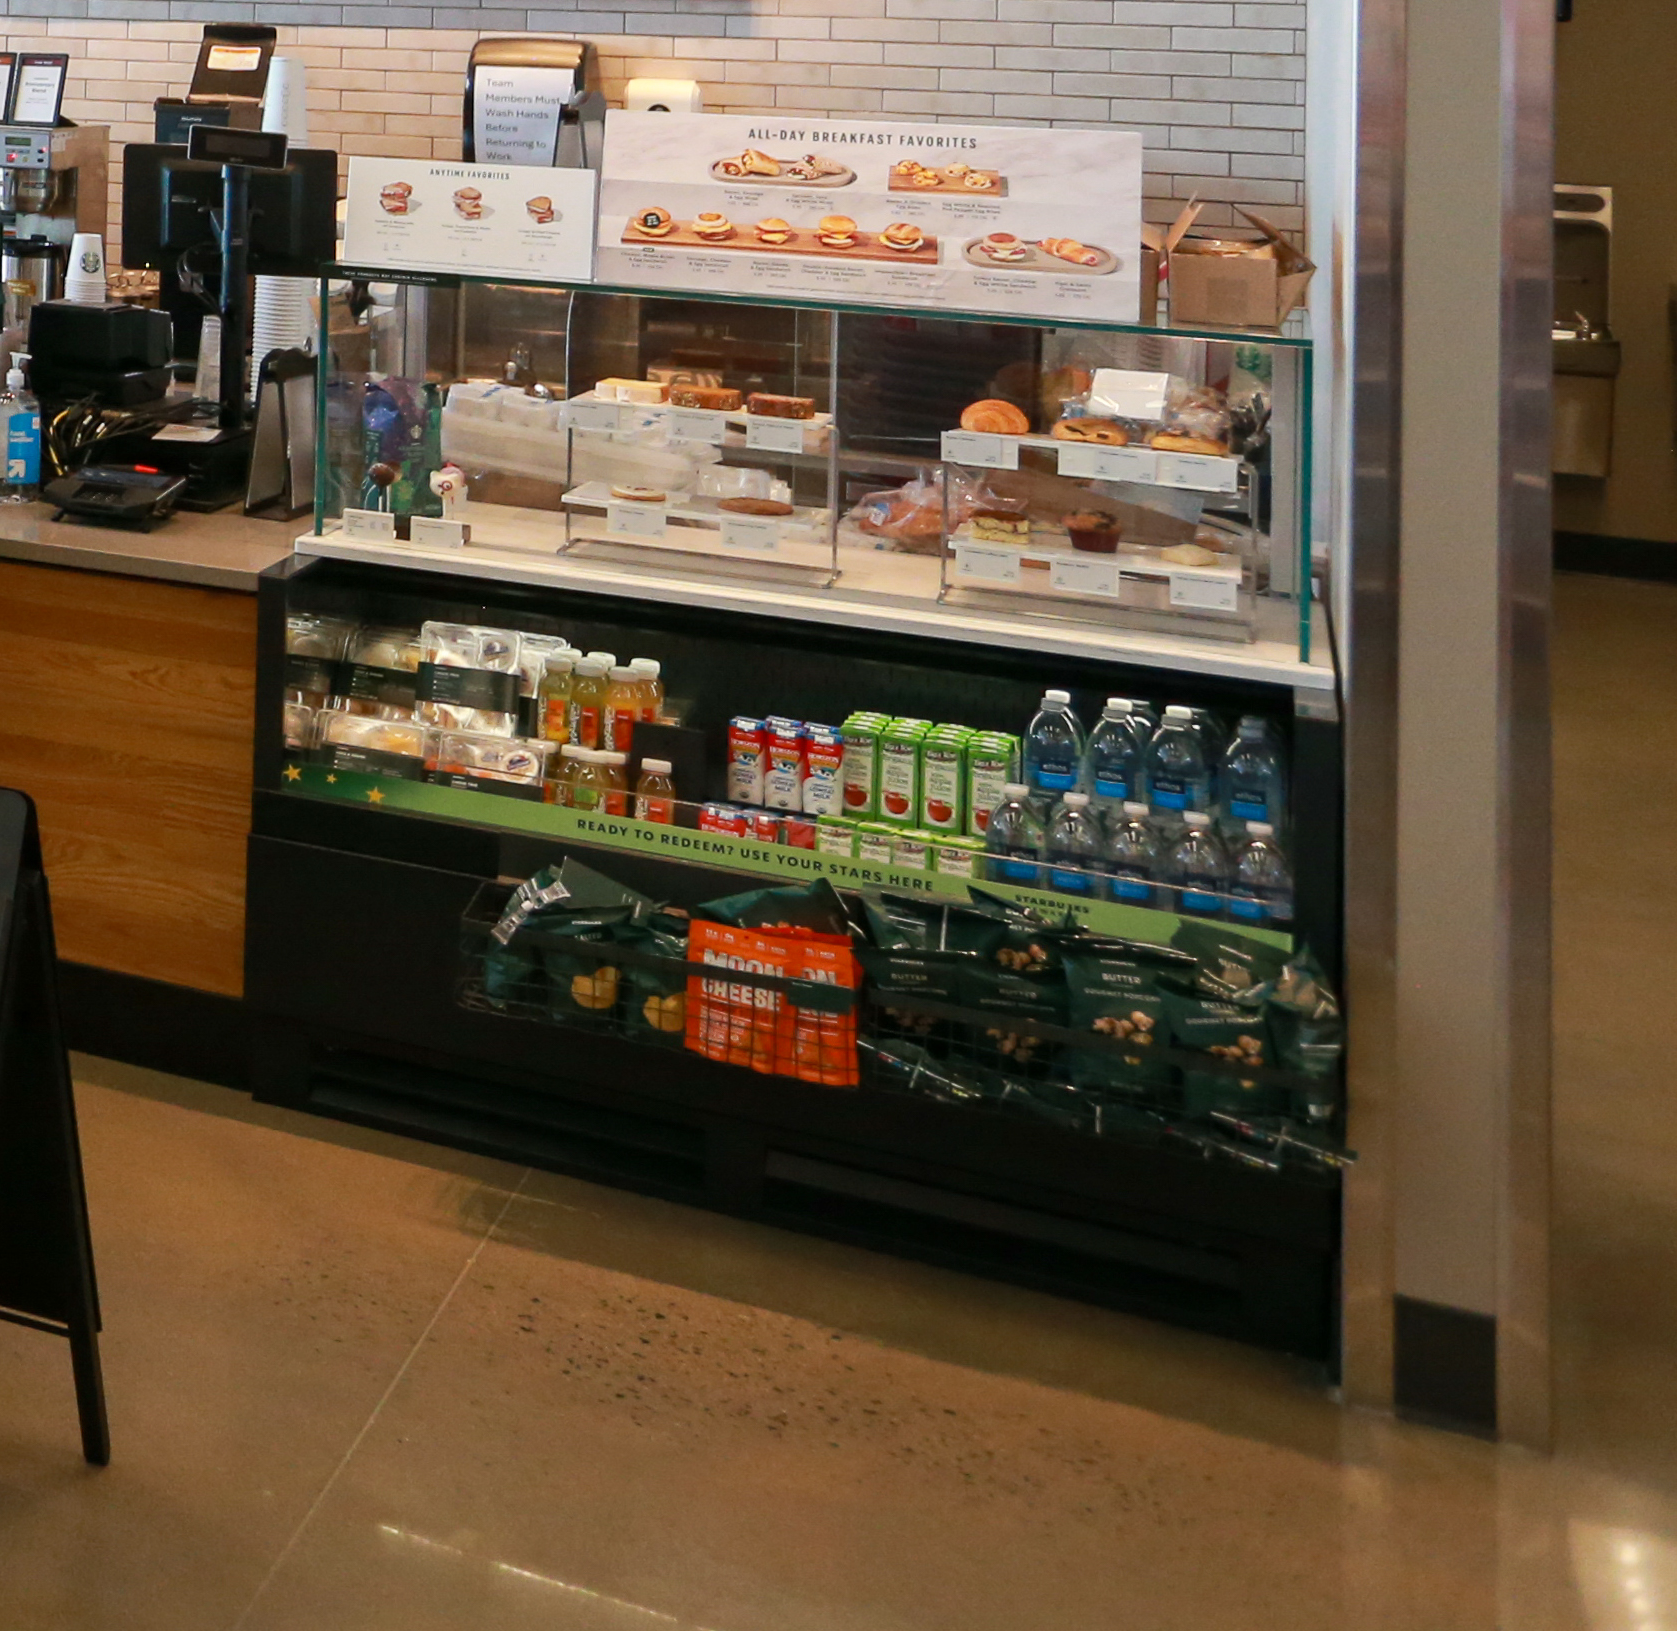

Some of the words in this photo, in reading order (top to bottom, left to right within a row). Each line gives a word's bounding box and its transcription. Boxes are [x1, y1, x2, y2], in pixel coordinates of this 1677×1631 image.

[487, 77, 514, 88] Team
[485, 94, 532, 104] Members
[535, 95, 560, 105] Must
[485, 109, 514, 118] Wash
[516, 109, 549, 120] Hands
[485, 123, 518, 133] Before
[485, 137, 534, 151] Returning
[536, 140, 547, 150] to
[748, 127, 805, 143] ALL-DAY
[812, 130, 893, 146] BREAKFAST
[899, 132, 978, 149] FAVORITES
[486, 151, 513, 161] Work
[430, 168, 465, 179] ANYTIME
[467, 170, 510, 181] FAVORITES
[577, 818, 627, 840] READY
[634, 828, 655, 843] TO
[660, 833, 734, 856] REDEEM?
[740, 847, 772, 862] USE
[776, 852, 823, 872] YOUR
[829, 864, 883, 884] STARS
[889, 874, 934, 892] HERE
[889, 972, 929, 983] BUTTER
[1100, 971, 1143, 986] BUTTER
[701, 978, 782, 1012] CHEESE
